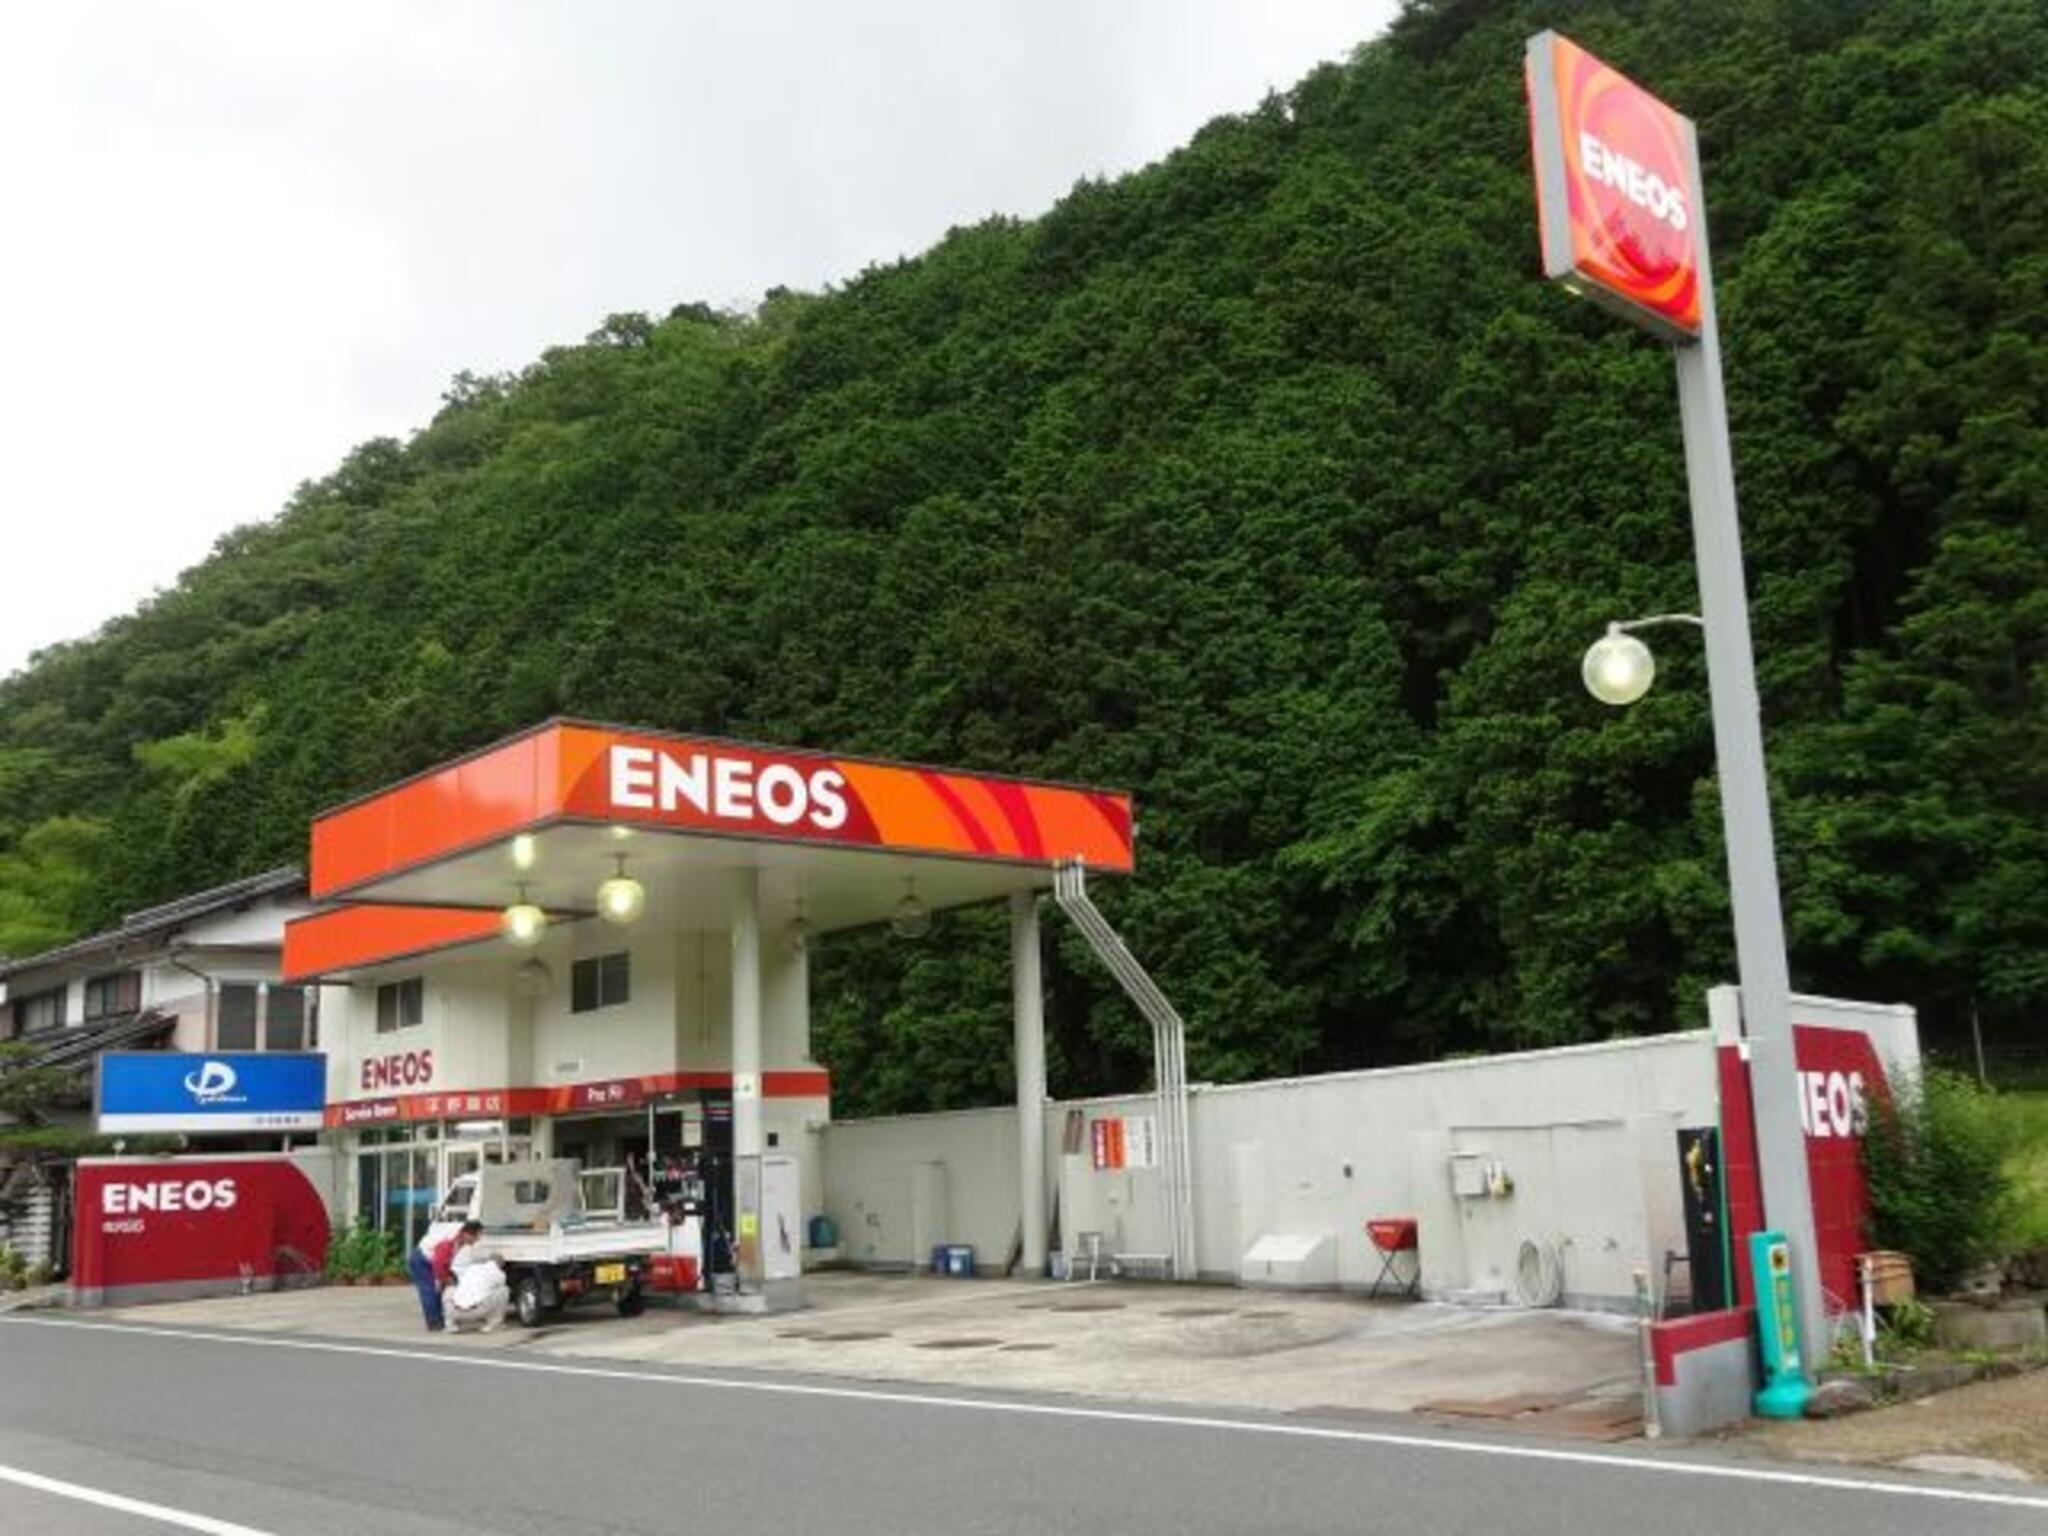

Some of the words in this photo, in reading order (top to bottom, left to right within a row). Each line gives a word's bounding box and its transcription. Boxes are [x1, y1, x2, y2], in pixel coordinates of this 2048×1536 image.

[1580, 130, 1687, 231] ENEOS
[610, 745, 848, 830] ENEOS
[361, 1050, 433, 1089] ENEOS
[102, 1179, 237, 1213] ENEOS
